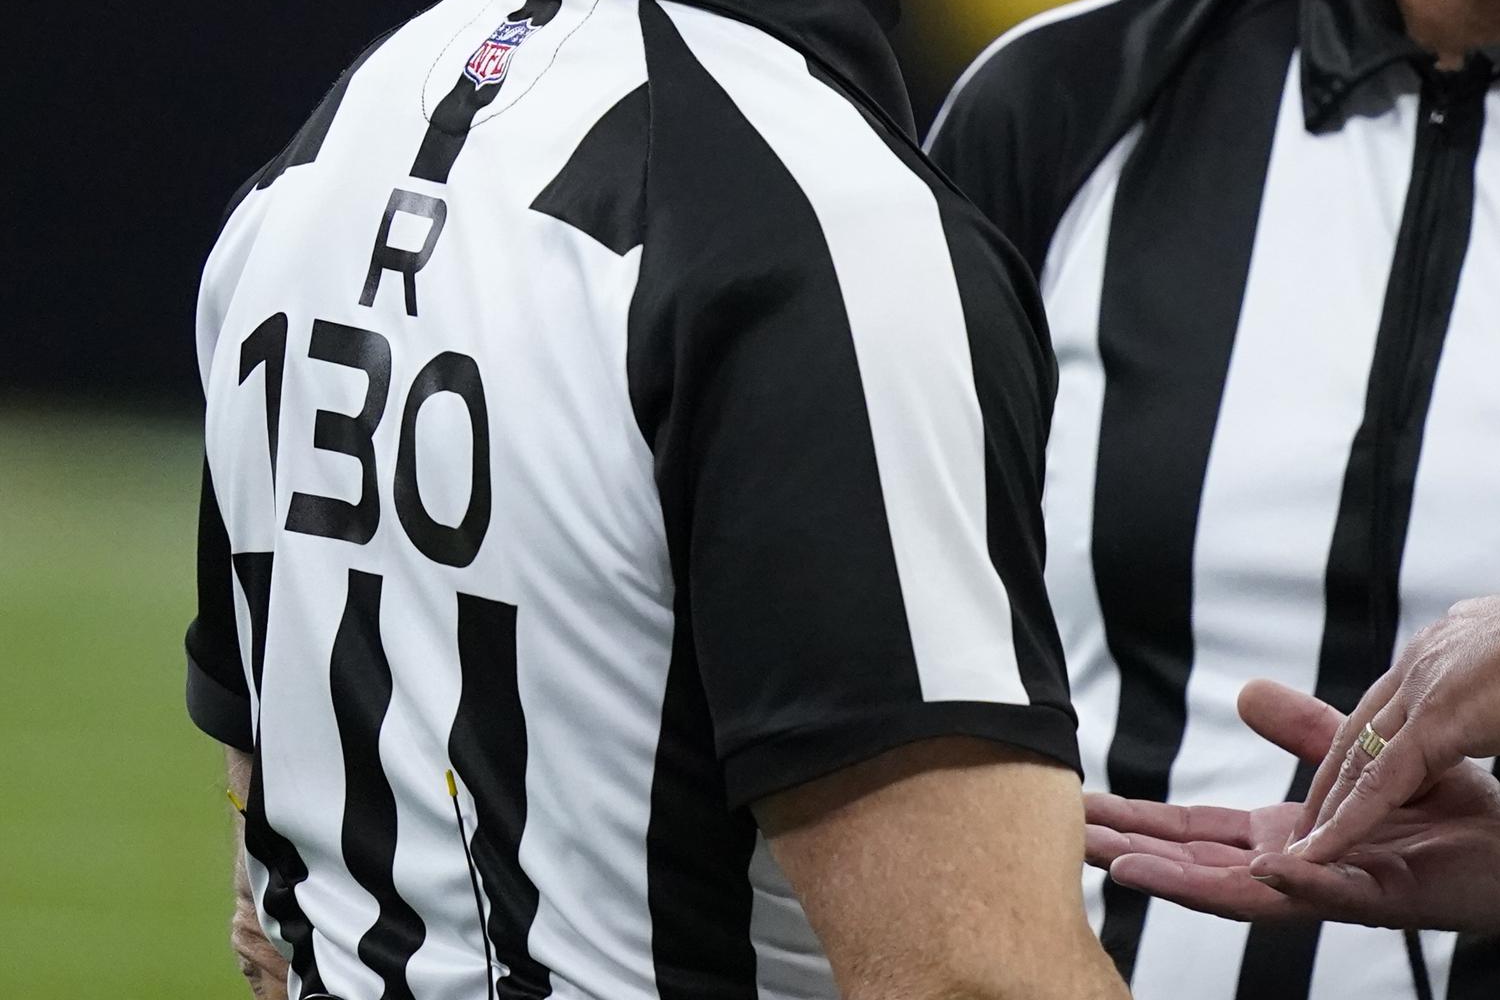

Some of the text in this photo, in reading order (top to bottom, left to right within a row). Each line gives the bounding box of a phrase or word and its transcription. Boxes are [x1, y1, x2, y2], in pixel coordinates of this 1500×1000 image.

[468, 42, 511, 78] NFL
[358, 187, 448, 317] R
[238, 311, 492, 568] 130
